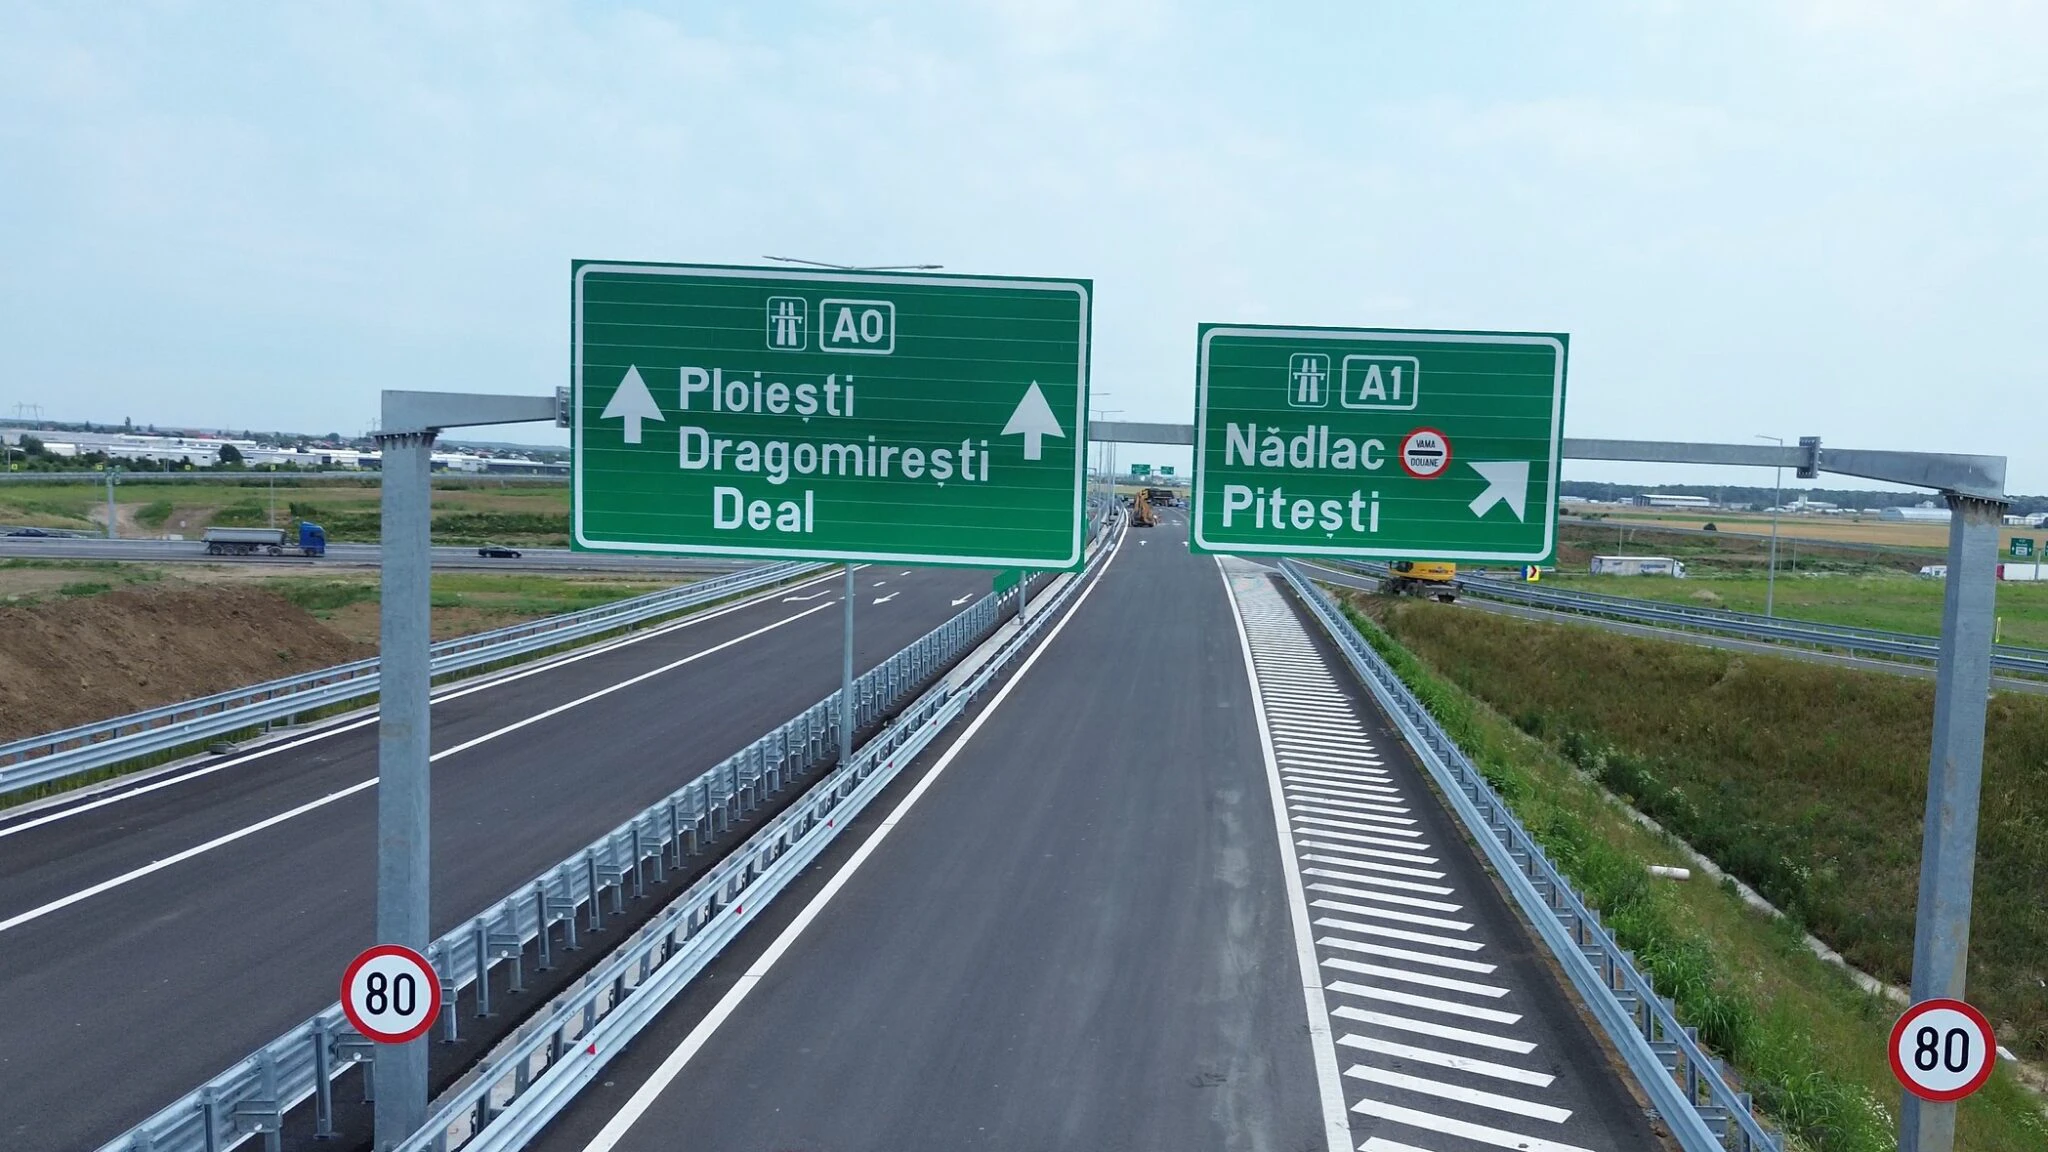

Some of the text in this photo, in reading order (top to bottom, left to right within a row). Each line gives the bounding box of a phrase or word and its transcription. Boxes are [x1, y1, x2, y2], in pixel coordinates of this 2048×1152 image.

[831, 307, 883, 343] A0
[680, 366, 854, 423] Ploiești
[1359, 364, 1402, 401] A1
[679, 426, 989, 487] Dragomirești
[1225, 422, 1385, 470] Nădlac
[1410, 458, 1439, 467] DOUANE
[1416, 439, 1436, 448] VAMA
[713, 486, 814, 533] Deal
[1222, 484, 1380, 539] Pitești
[365, 971, 416, 1017] 80
[1914, 1026, 1970, 1073] 80
